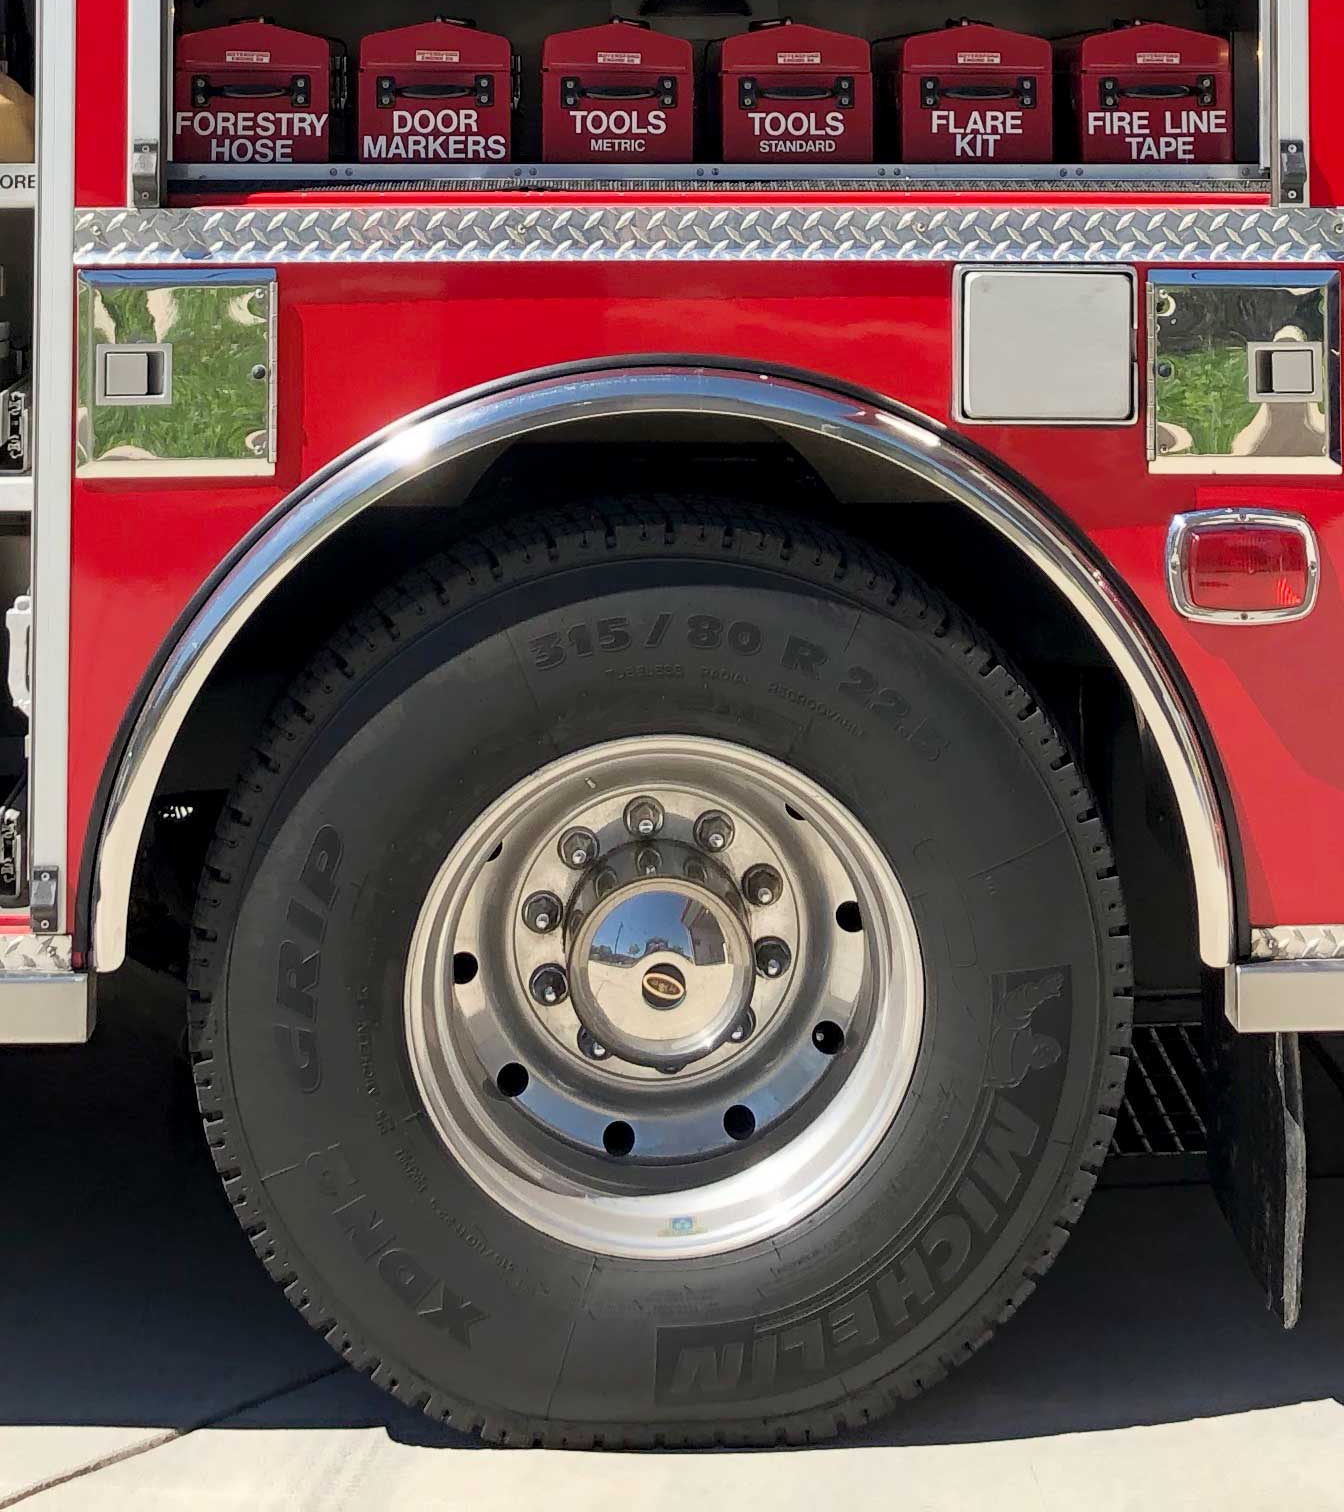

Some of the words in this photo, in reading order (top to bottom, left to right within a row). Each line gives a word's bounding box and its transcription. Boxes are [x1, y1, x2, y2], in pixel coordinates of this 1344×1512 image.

[175, 111, 329, 137] FORESTRY
[392, 109, 478, 134] DOOR
[569, 110, 667, 135] TOOLS
[747, 111, 845, 136] TOOLS
[931, 110, 1023, 134] FLARE
[1087, 111, 1150, 135] FIRE
[1164, 110, 1227, 134] LINE
[211, 138, 293, 163] HOSE
[363, 135, 506, 159] MARKERS
[590, 138, 646, 152] METRIC
[759, 139, 836, 153] STANDARD
[955, 133, 1001, 157] KIT
[1124, 136, 1195, 160] TAPE
[779, 635, 830, 680] R
[272, 824, 344, 1095] GRIP
[669, 1091, 1043, 1394] MICHELIN
